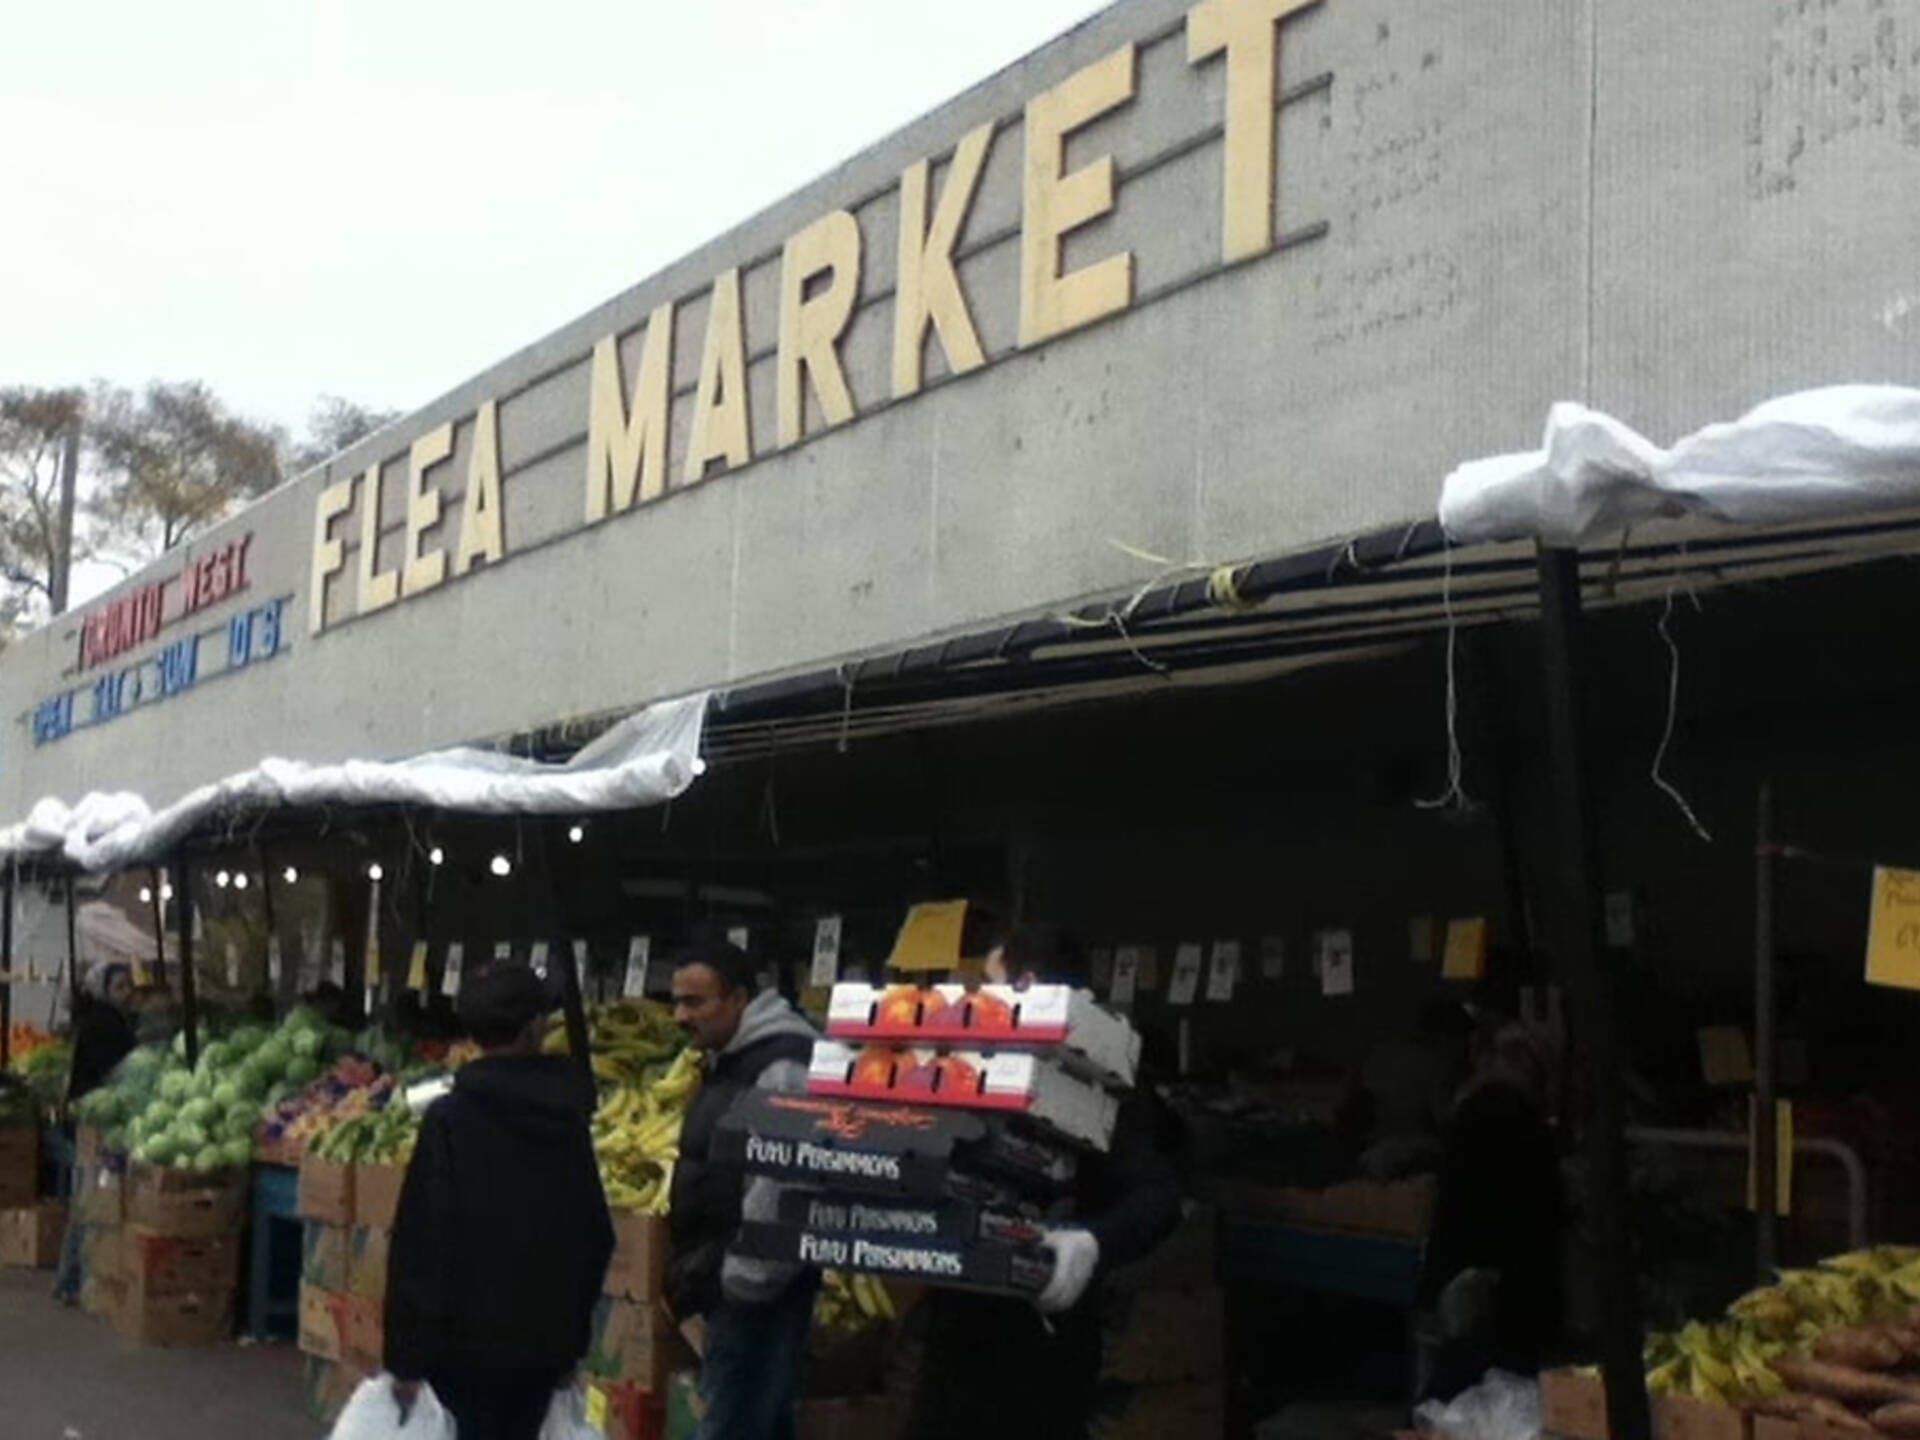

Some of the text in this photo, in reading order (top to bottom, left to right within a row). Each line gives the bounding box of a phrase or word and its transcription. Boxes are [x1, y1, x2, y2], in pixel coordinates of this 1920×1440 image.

[309, 0, 1325, 634] FLEA MARKET
[181, 533, 254, 618] WEST
